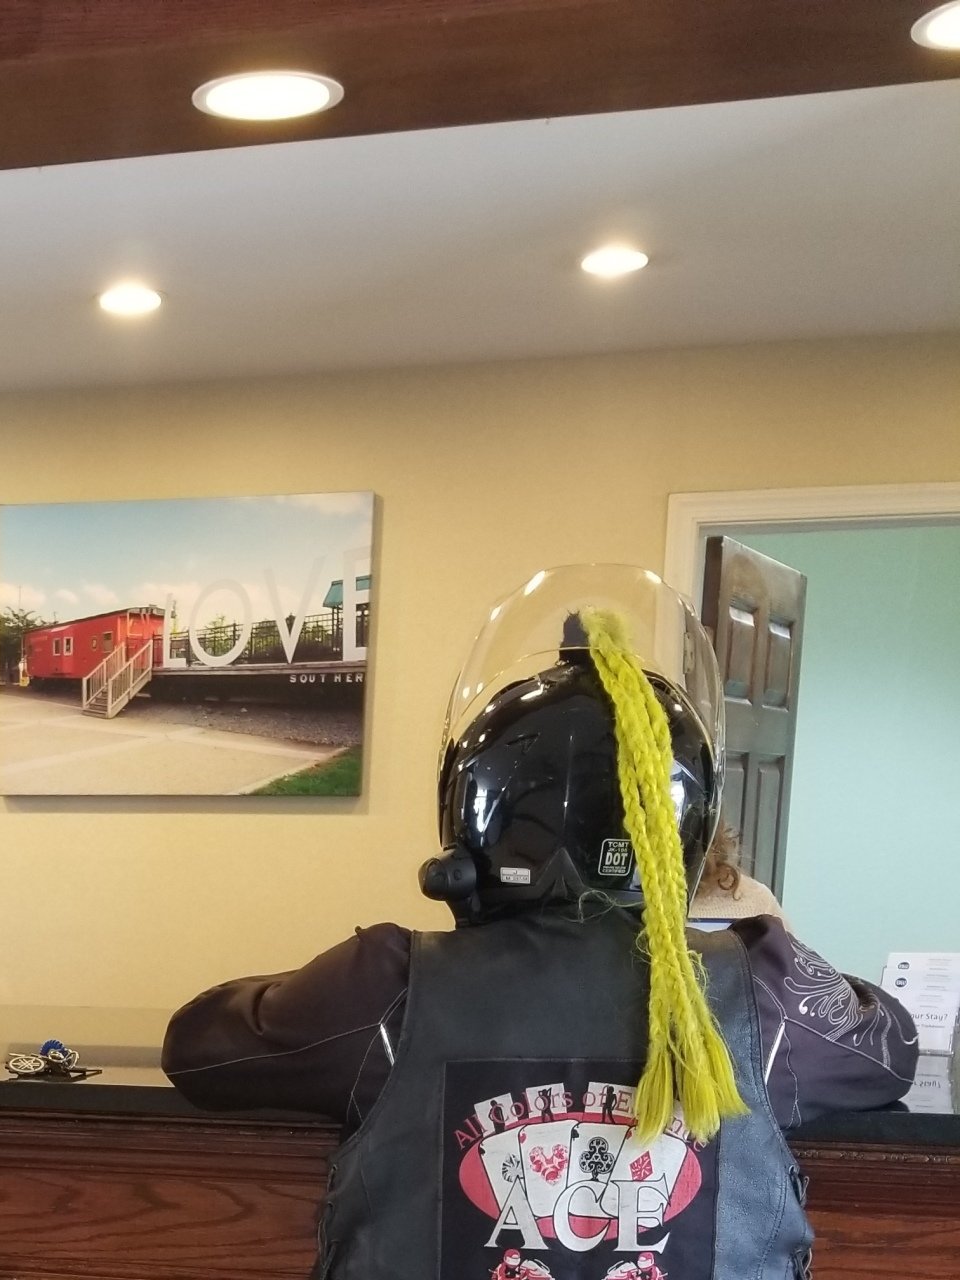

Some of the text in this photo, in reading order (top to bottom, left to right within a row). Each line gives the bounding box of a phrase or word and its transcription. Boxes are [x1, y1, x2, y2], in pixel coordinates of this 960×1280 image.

[163, 549, 372, 668] LOVE
[605, 852, 628, 866] DOT
[926, 1013, 948, 1021] Stay?
[454, 1114, 488, 1150] All
[490, 1089, 574, 1125] Colors
[484, 1173, 672, 1254] ACE
